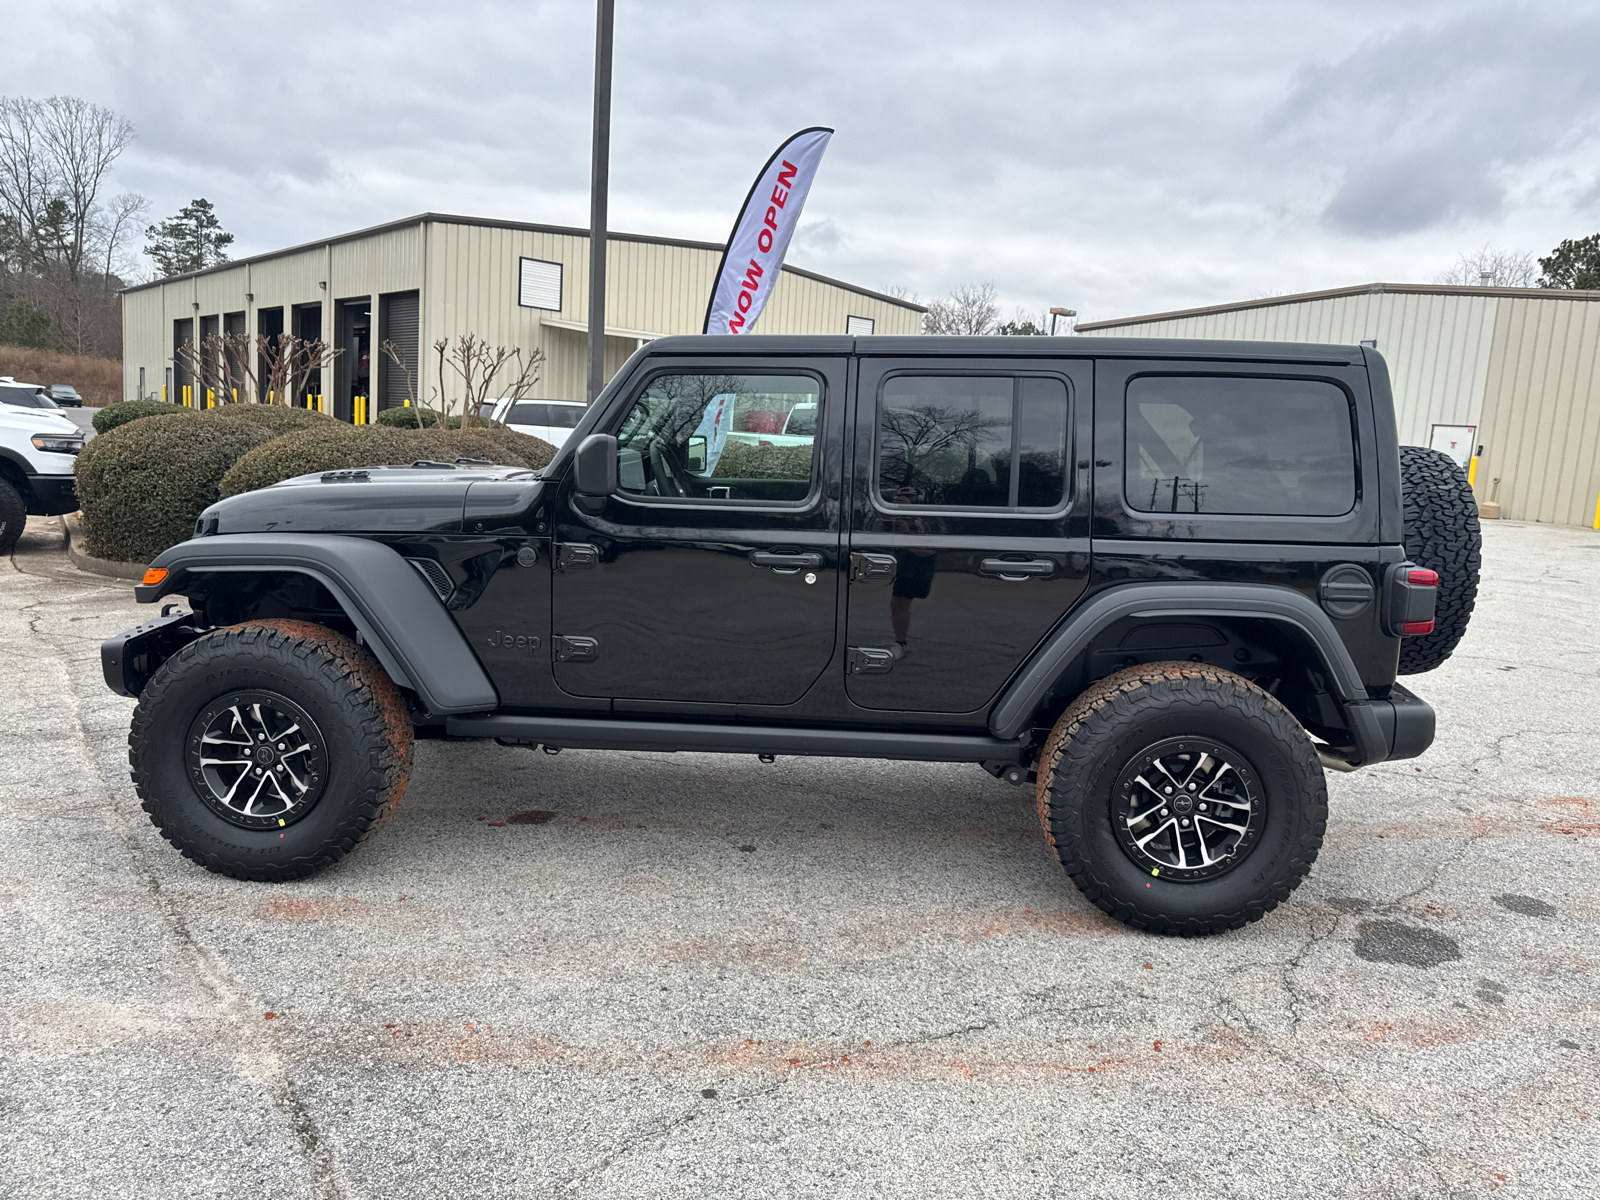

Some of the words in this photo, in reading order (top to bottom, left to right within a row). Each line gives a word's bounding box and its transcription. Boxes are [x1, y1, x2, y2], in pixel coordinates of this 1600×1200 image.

[729, 258, 764, 334] NOW
[757, 159, 798, 253] OPEN
[487, 630, 541, 653] Jeep
